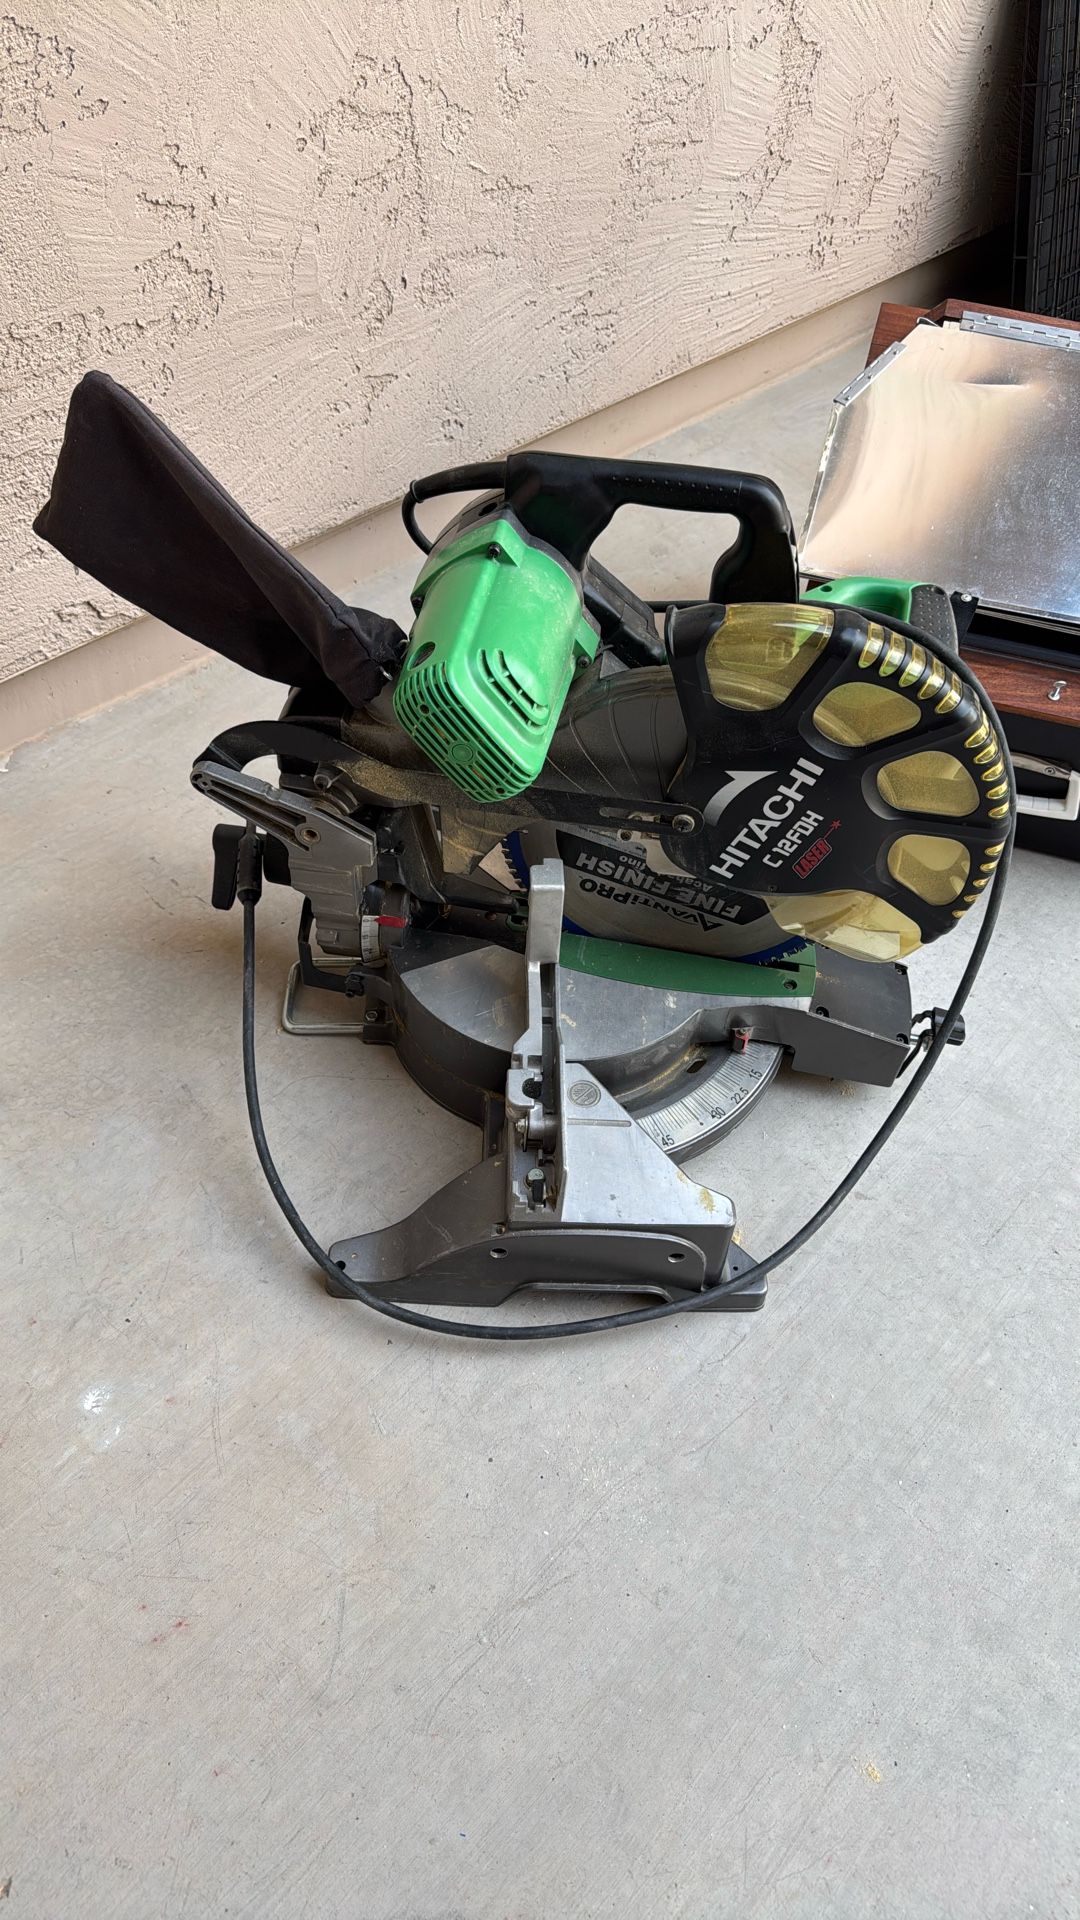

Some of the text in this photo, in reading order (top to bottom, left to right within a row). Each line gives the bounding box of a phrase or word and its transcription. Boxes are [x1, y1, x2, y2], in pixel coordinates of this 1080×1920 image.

[709, 757, 825, 879] HITACHI
[762, 810, 825, 868] C 12FDH
[618, 854, 647, 871] fino
[795, 838, 830, 877] LASER
[575, 852, 743, 919] FINE FINISH
[748, 1069, 763, 1081] 15
[730, 1087, 749, 1105] 22.5
[712, 1106, 726, 1120] 30
[661, 1134, 675, 1147] 45
